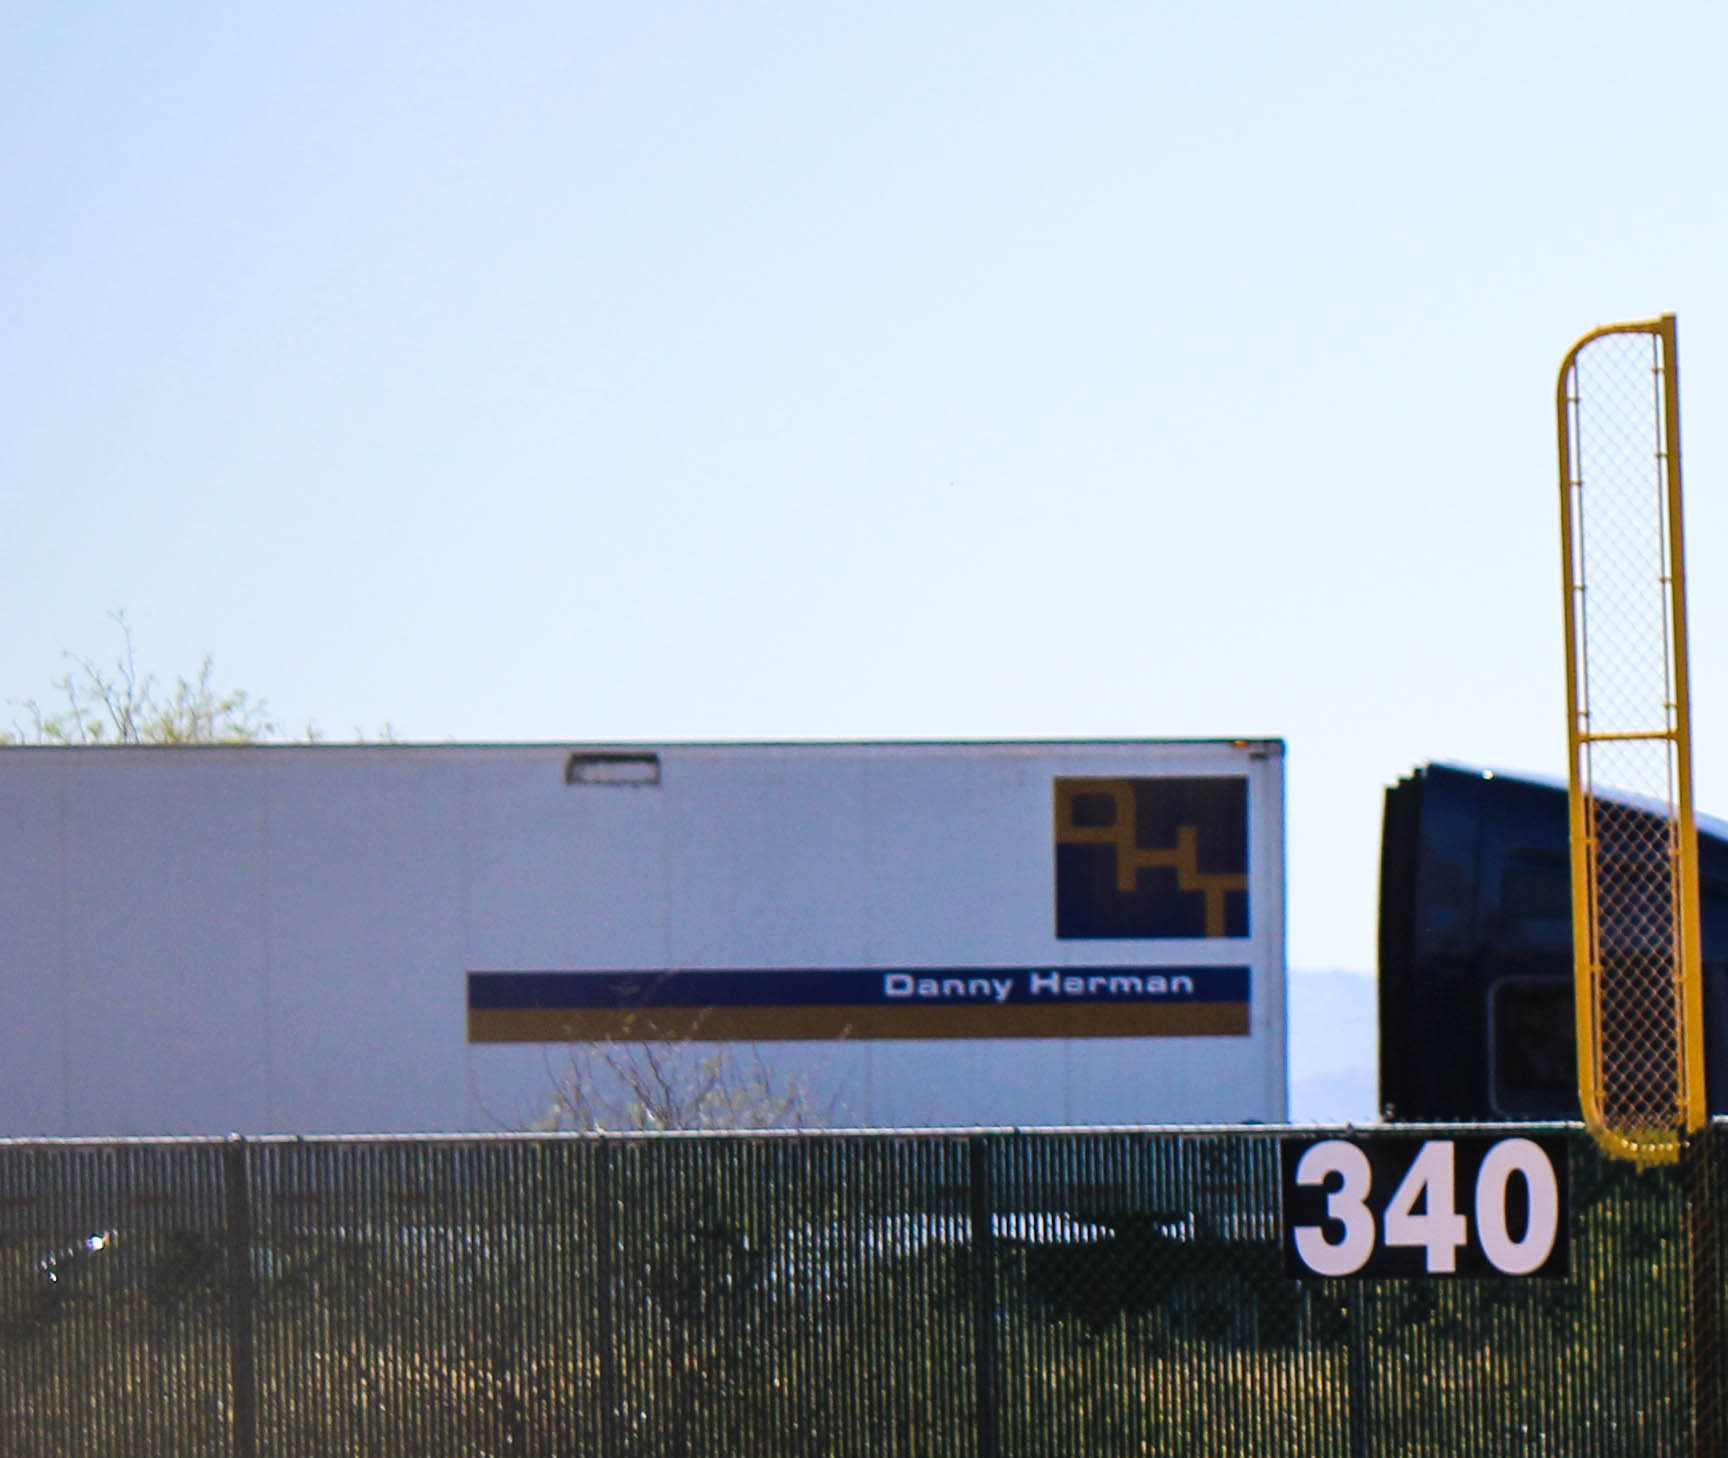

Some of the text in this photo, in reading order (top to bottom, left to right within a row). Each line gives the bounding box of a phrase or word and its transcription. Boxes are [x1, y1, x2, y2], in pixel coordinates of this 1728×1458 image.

[884, 971, 1194, 1003] Danny Herman
[1294, 1138, 1559, 1276] 340
